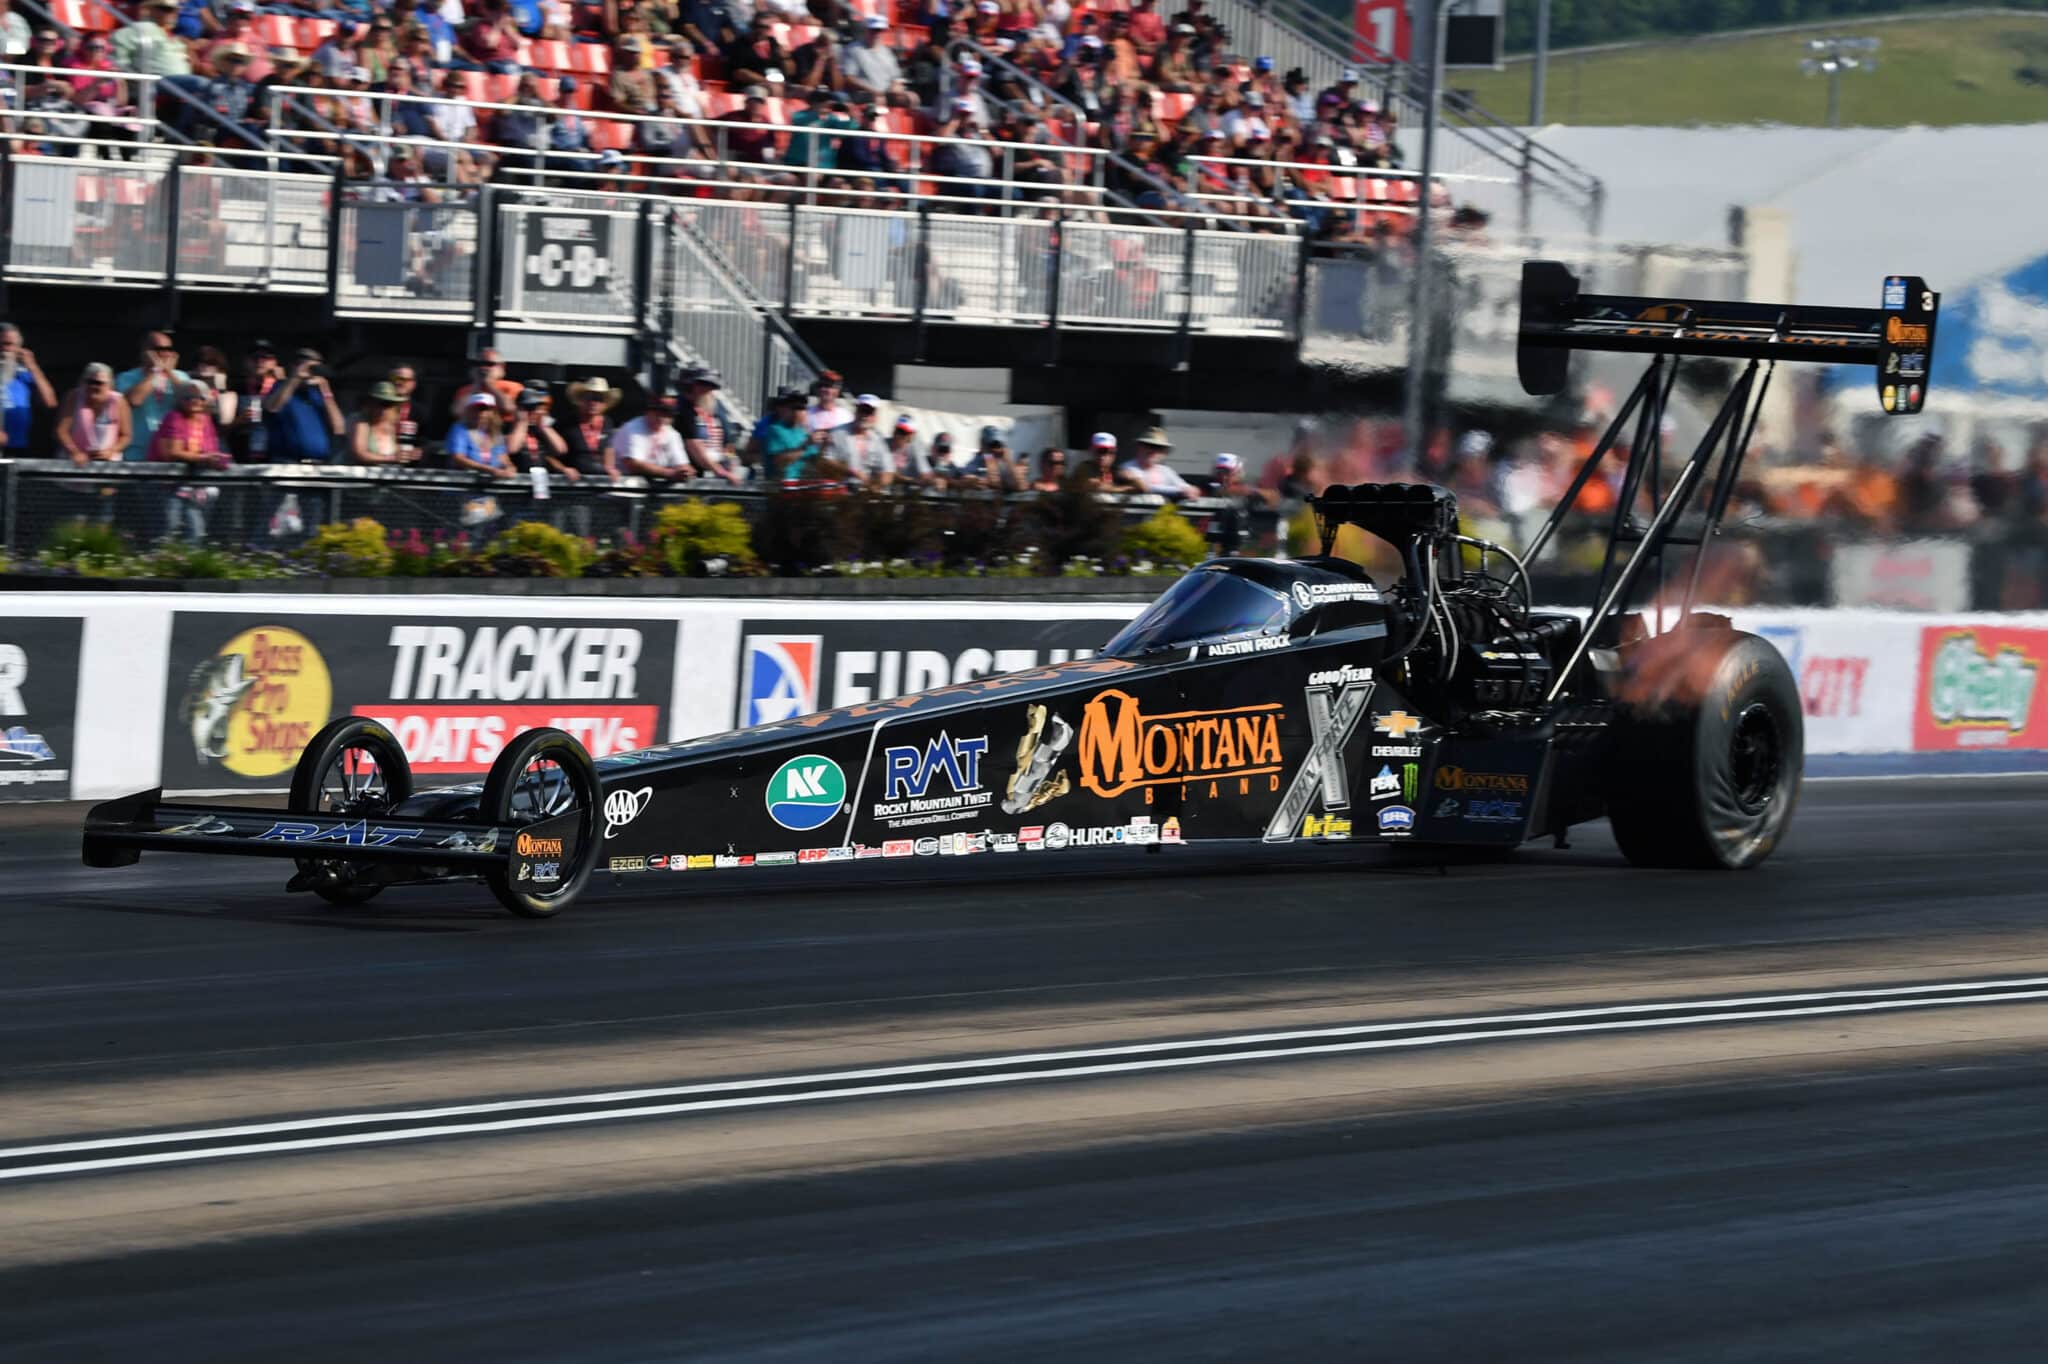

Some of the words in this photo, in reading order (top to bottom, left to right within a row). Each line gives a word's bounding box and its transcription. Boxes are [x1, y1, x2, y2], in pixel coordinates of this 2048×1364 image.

[1368, 7, 1395, 57] 1
[1920, 291, 1934, 312] 3
[1311, 583, 1377, 594] CORNWELL
[246, 633, 303, 674] Bass
[1208, 640, 1254, 657] AUSTIN
[1255, 634, 1292, 651] PROCK
[388, 625, 643, 700] TRACKER
[1308, 664, 1374, 687] GOODYEAR
[1079, 689, 1283, 798] MONTANA
[1371, 745, 1423, 757] CHEVROLET
[885, 729, 989, 800] RMT
[1434, 764, 1529, 791] MONTANA
[786, 764, 829, 799] NK
[1370, 774, 1401, 795] PEAK
[874, 802, 909, 817] ROCKY
[910, 796, 962, 812] MOUNTAIN
[963, 791, 993, 806] TWIST
[254, 818, 425, 847] RMT
[517, 833, 563, 856] MONTANA
[1069, 826, 1125, 845] HURCO
